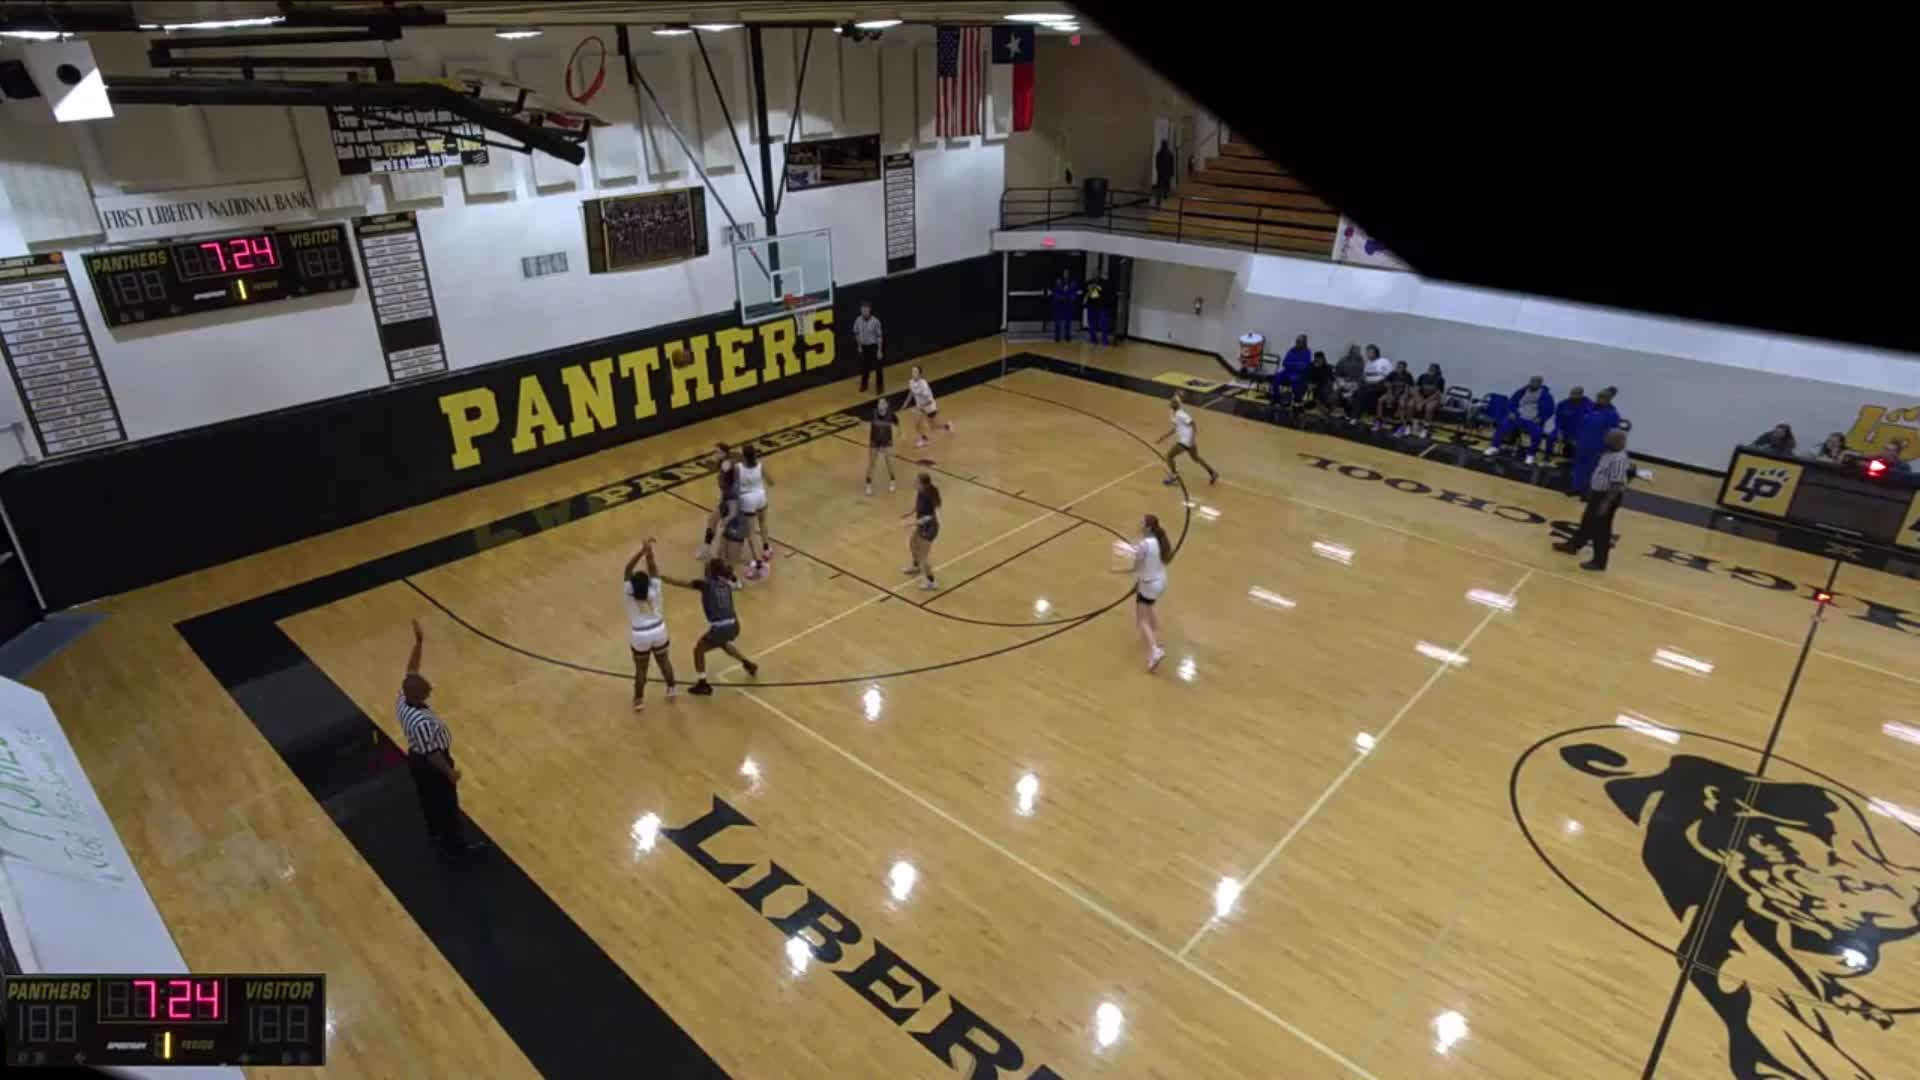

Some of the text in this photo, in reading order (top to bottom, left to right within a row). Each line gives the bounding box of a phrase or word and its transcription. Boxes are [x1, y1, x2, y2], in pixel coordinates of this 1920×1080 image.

[103, 191, 313, 230] FIRST LIBERTY NATIONAL BANK
[289, 228, 339, 248] VISITOR
[92, 250, 168, 273] PANTHERS
[438, 309, 836, 471] PANTHERS
[660, 793, 1065, 1080] LIBER
